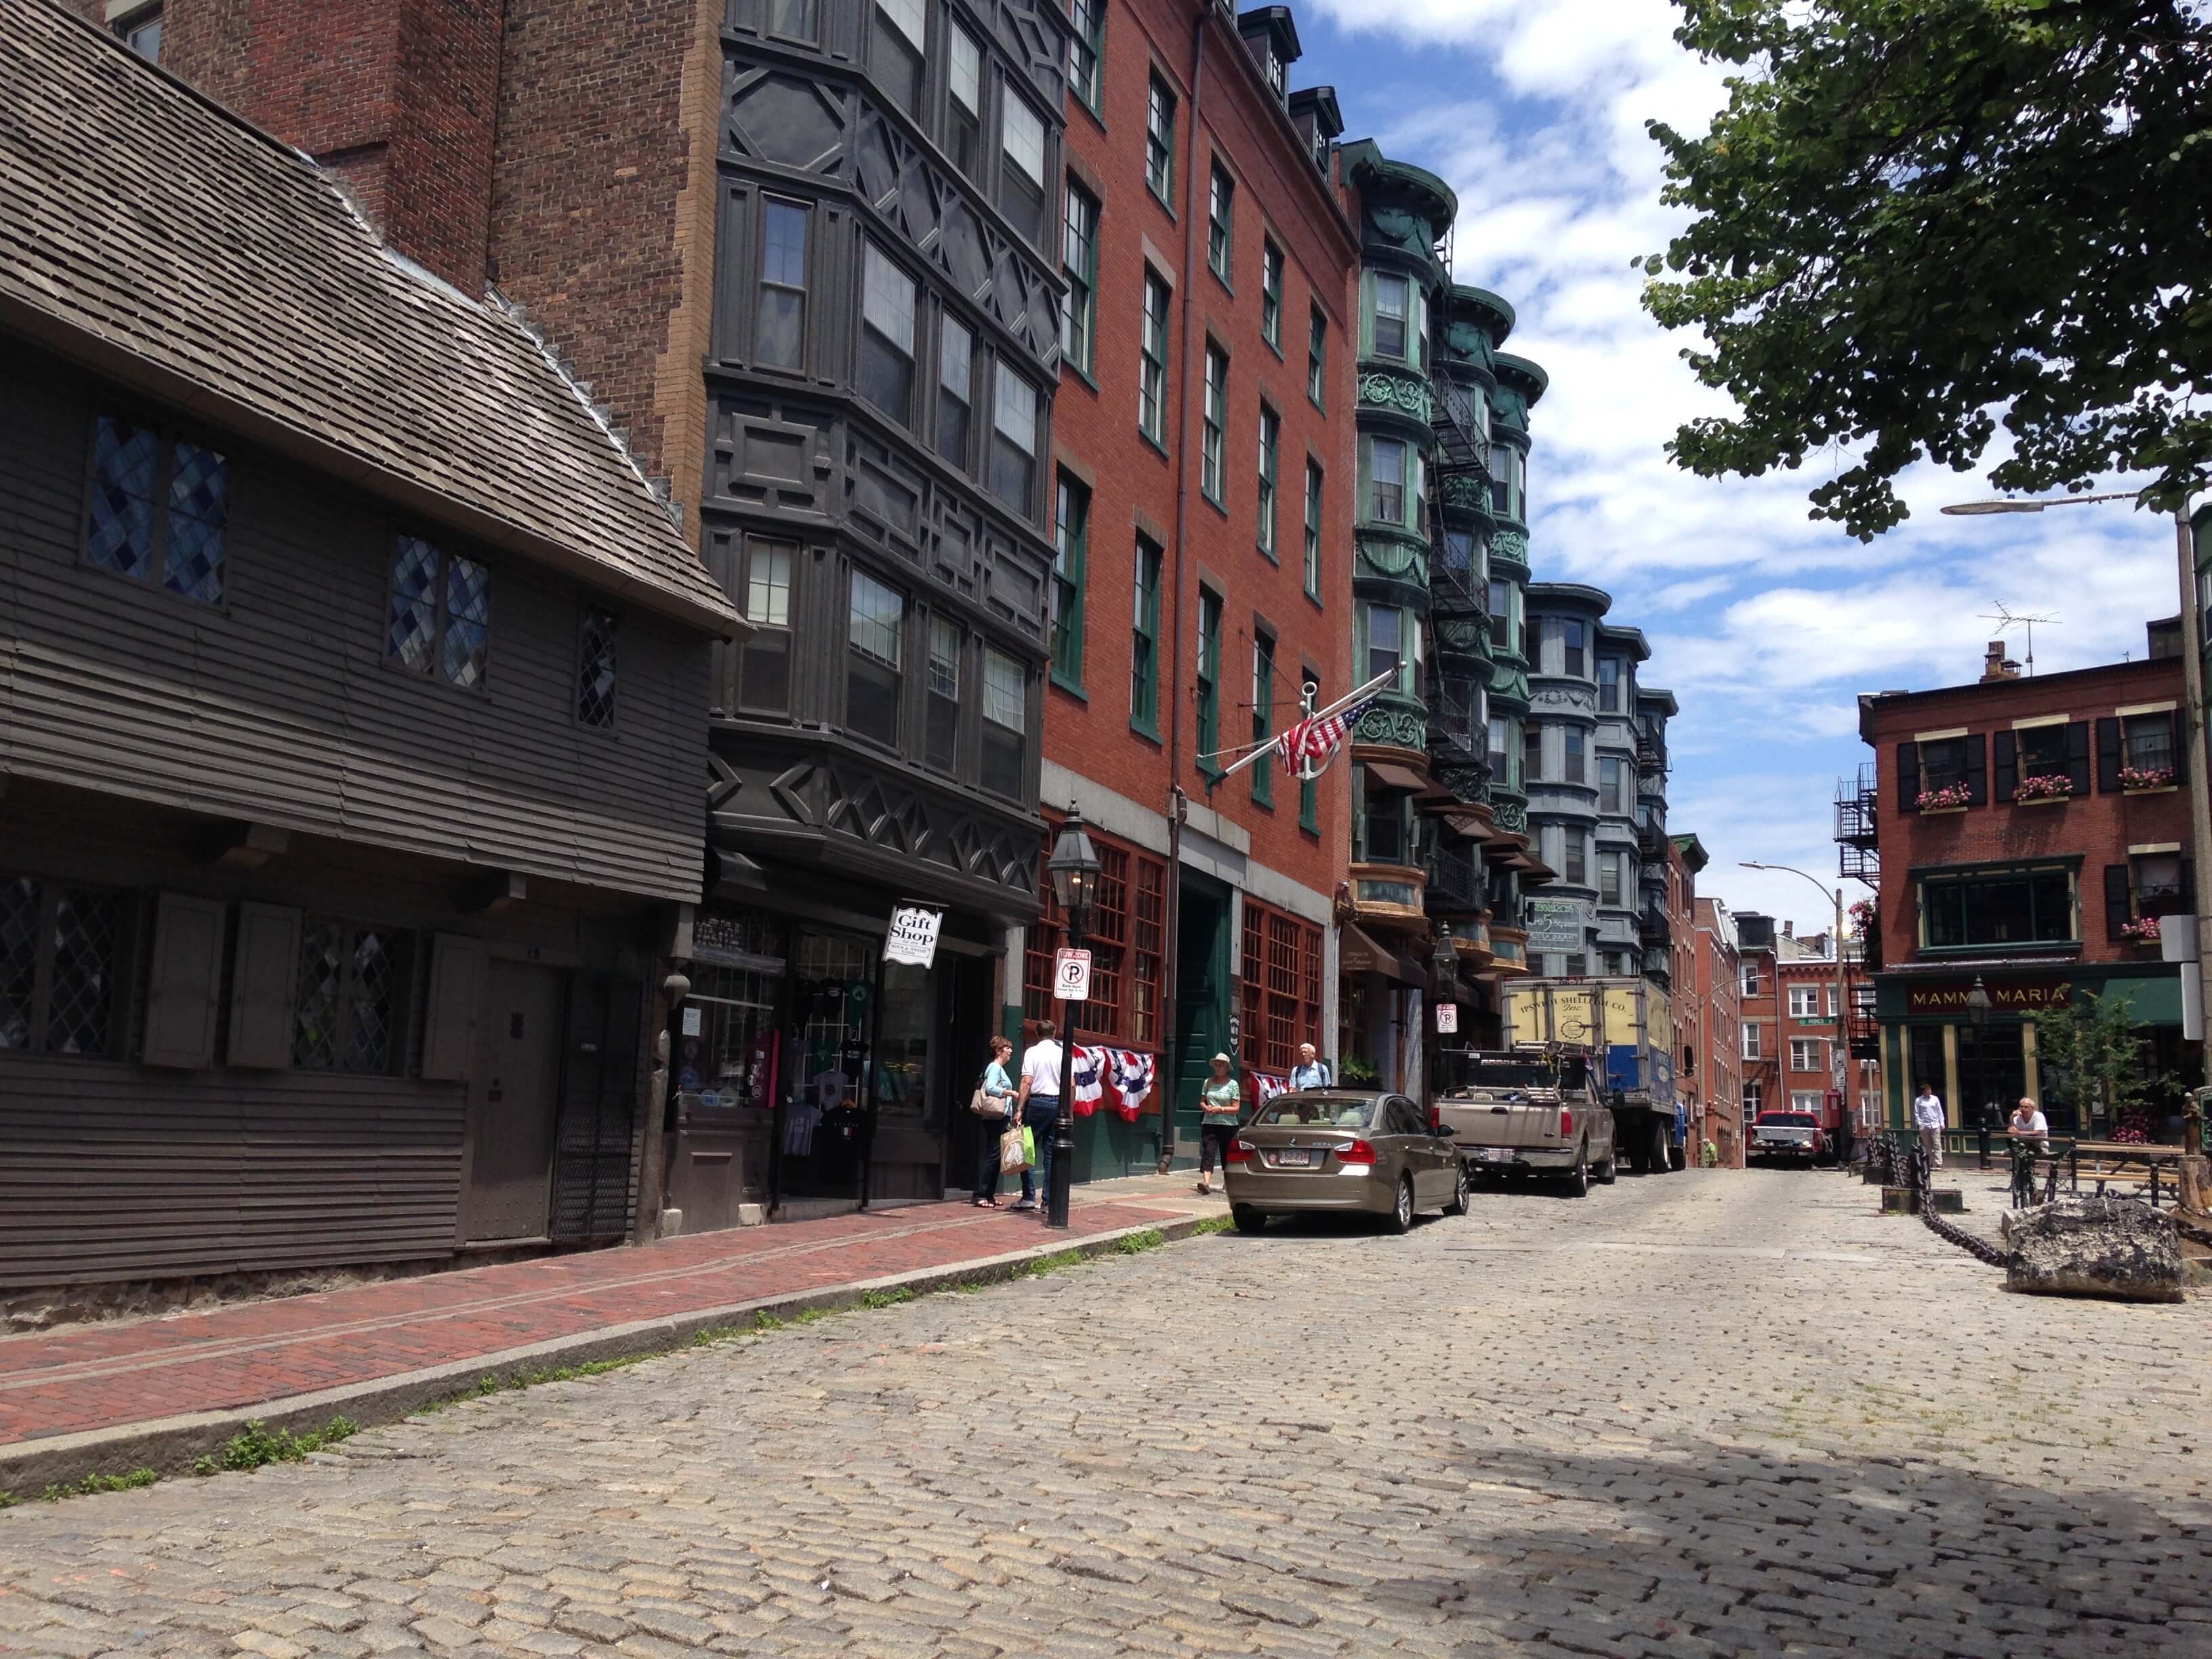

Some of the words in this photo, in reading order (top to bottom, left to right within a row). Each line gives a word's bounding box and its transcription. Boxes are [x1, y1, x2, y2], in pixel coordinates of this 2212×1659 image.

[898, 914, 930, 930] Gift
[889, 926, 934, 946] Shop
[1073, 951, 1088, 960] ZONE
[1913, 991, 1975, 1005] MAMM
[1996, 988, 2065, 1002] MARIA
